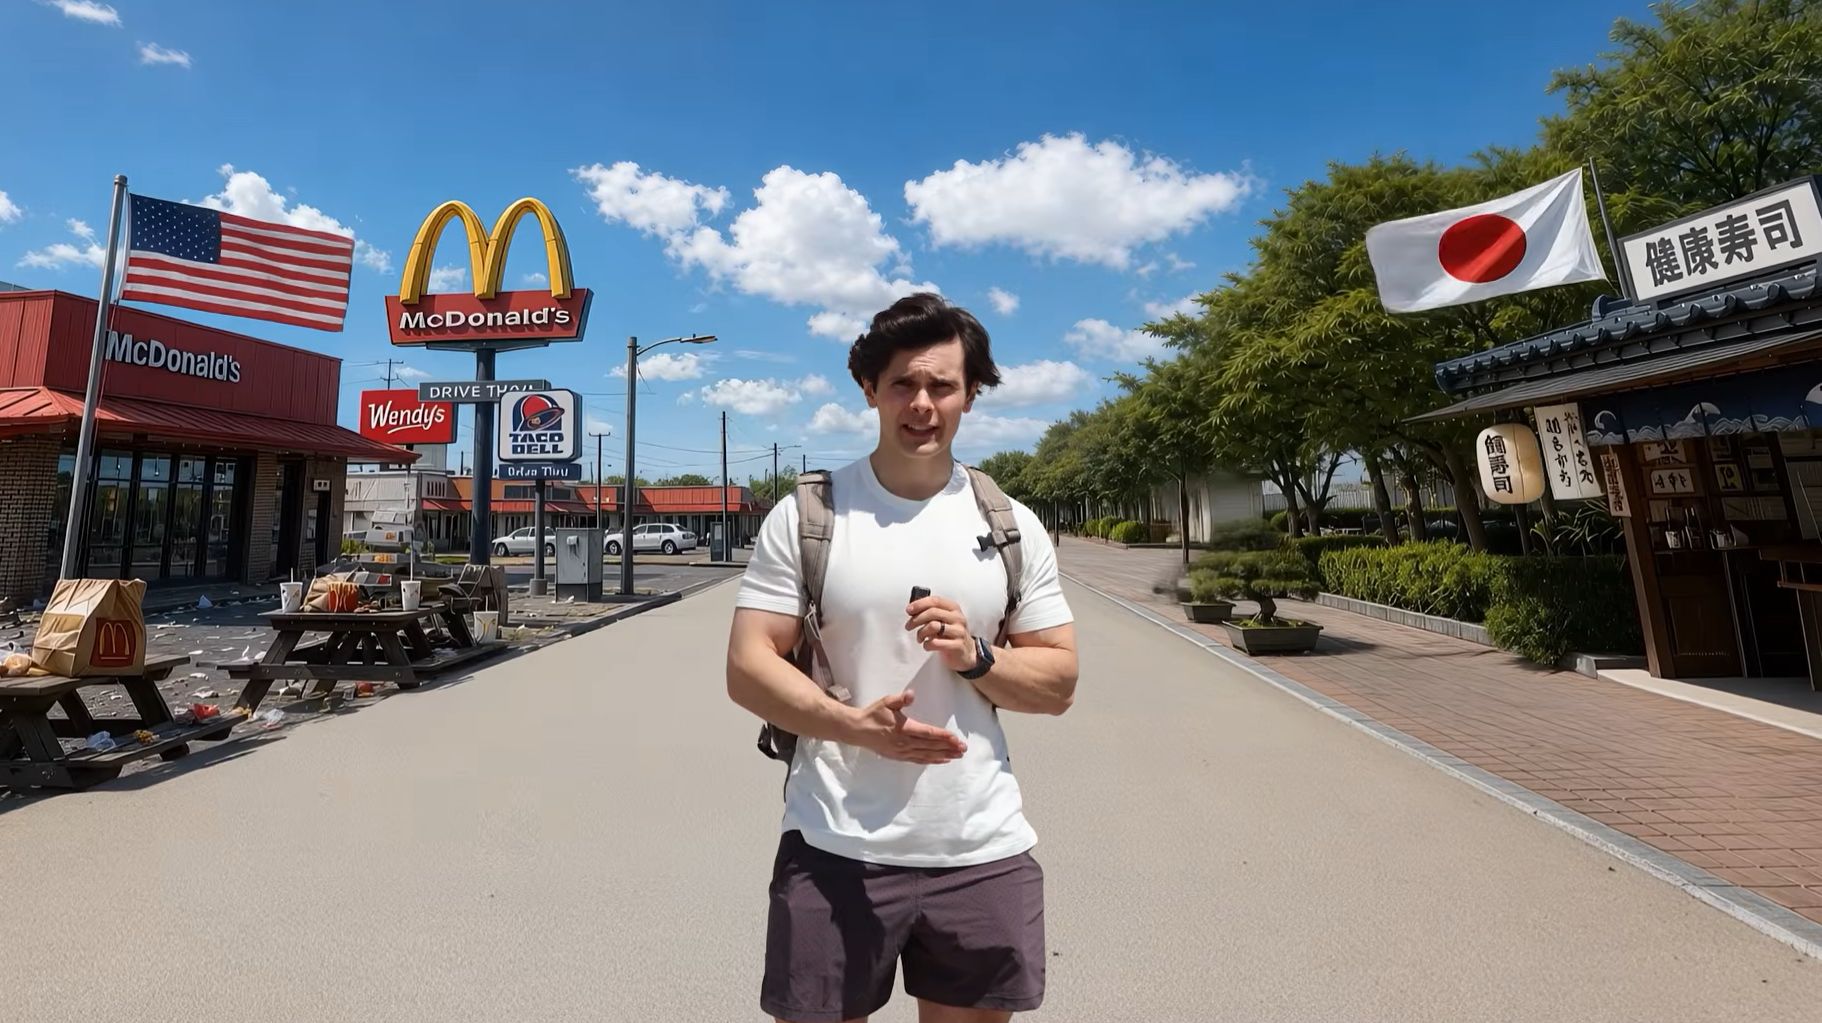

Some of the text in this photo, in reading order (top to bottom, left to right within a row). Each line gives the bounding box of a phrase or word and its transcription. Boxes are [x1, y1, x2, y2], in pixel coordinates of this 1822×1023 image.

[1645, 199, 1803, 288] 健康寿司
[400, 307, 570, 329] McDonald's
[105, 329, 241, 383] McDonald's
[430, 385, 480, 399] DRIVE
